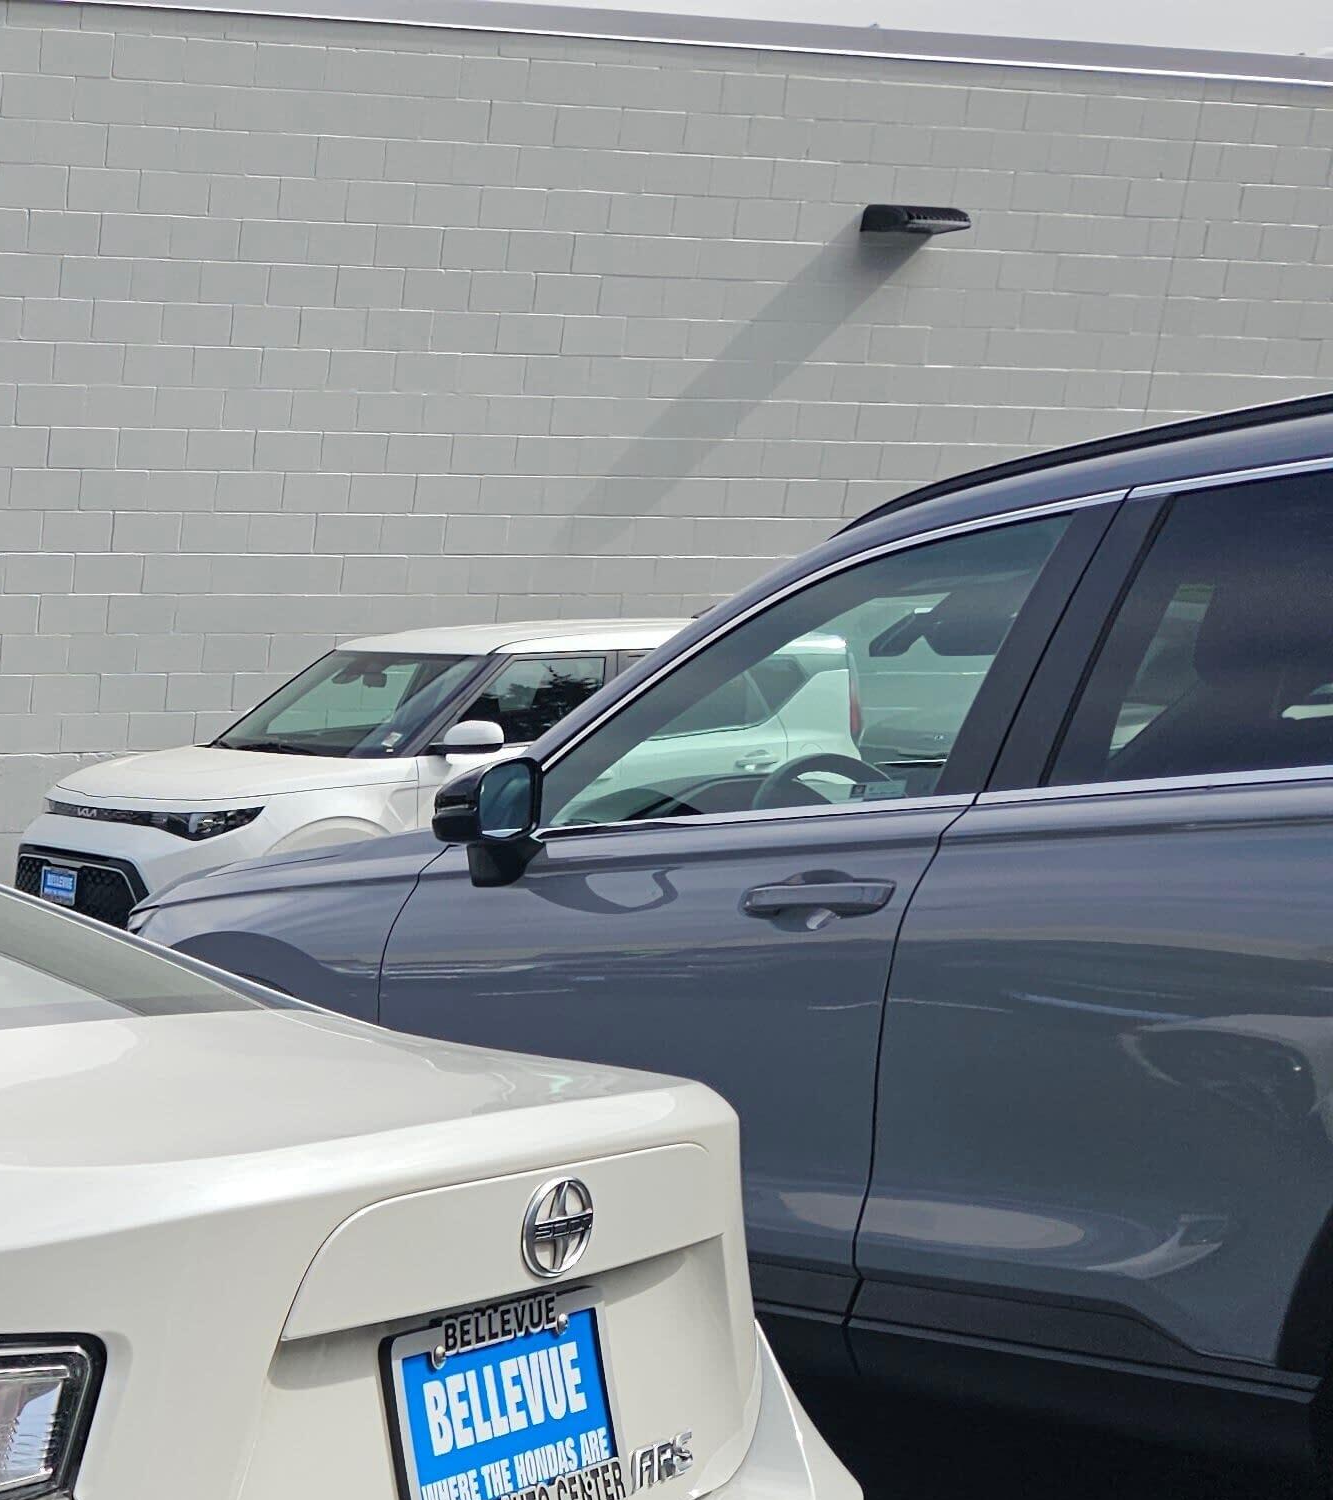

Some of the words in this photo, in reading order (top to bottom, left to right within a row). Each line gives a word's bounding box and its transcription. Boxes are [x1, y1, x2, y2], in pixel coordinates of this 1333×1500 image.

[444, 1295, 558, 1352] BELLEVUE
[423, 1341, 587, 1456] BELLEVUE
[480, 1458, 511, 1499] THE
[513, 1436, 578, 1489] HONDAS
[579, 1427, 610, 1467] ARE
